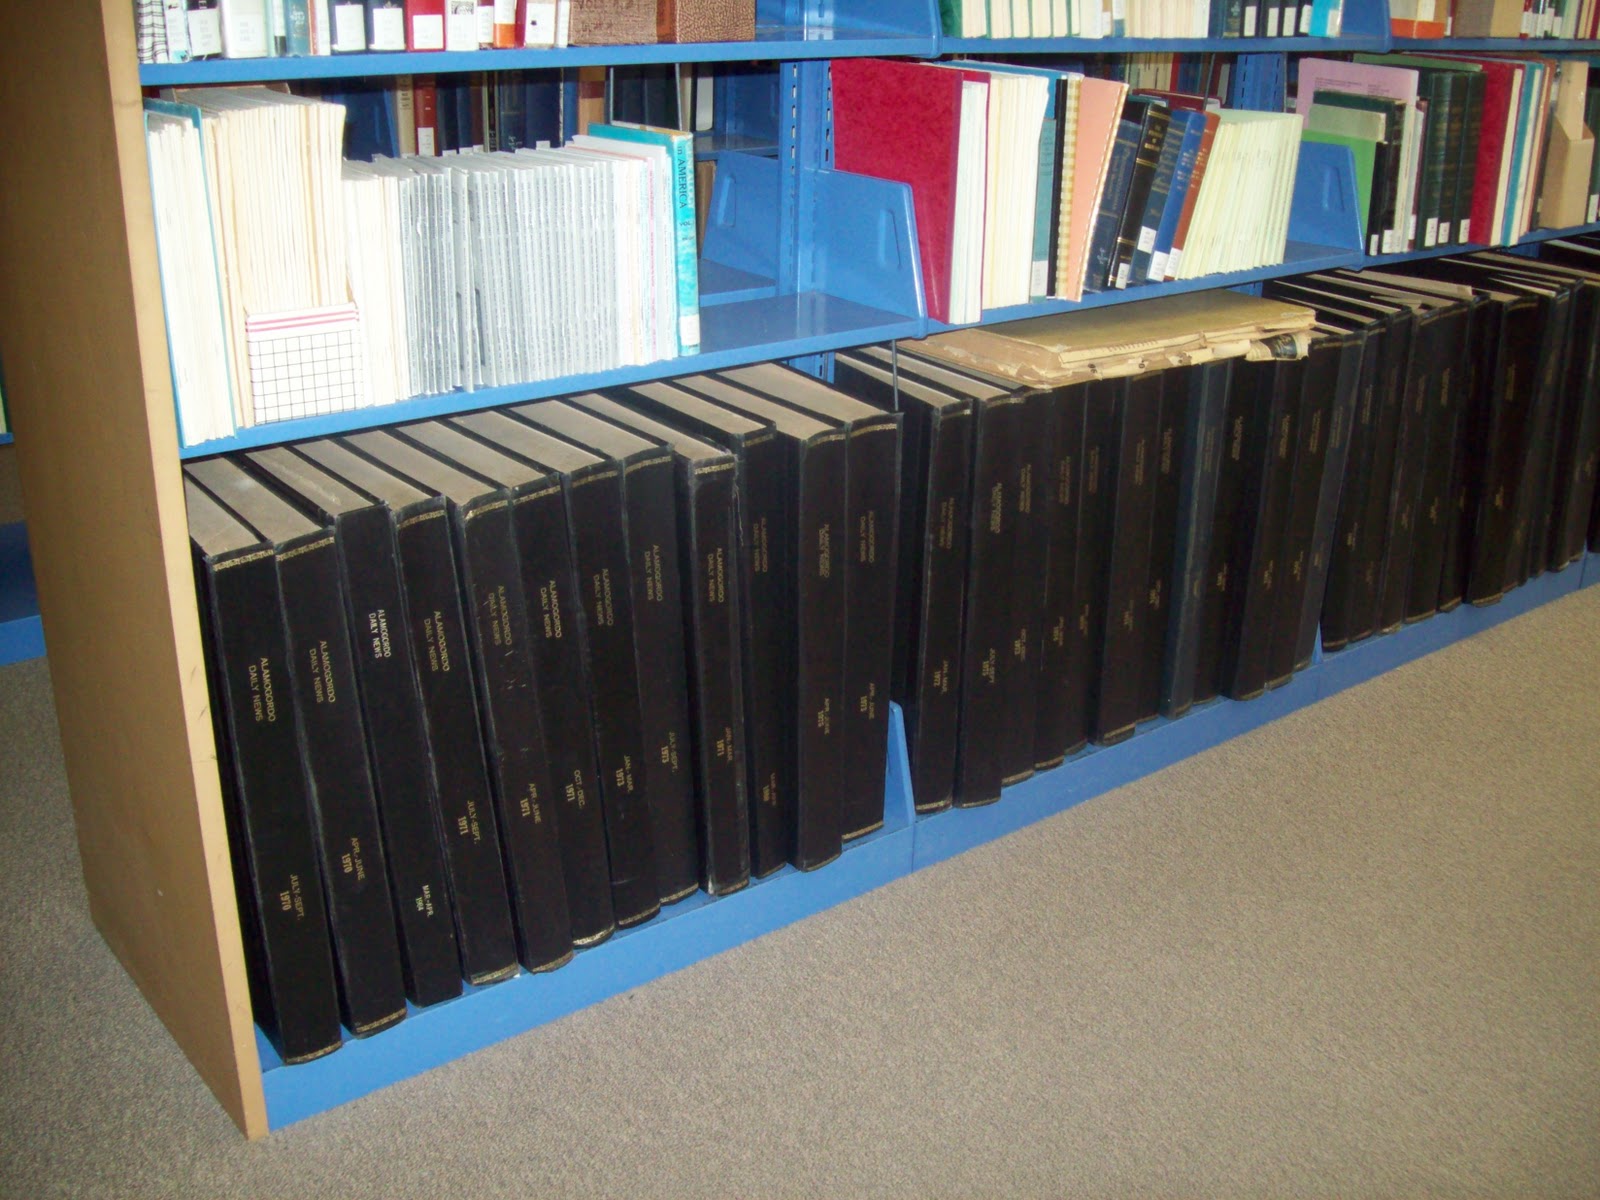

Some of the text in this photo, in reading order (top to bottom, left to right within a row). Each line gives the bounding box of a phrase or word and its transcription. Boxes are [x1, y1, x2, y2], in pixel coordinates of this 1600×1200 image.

[677, 146, 687, 208] in AMERICA
[601, 569, 614, 626] ALAMOGORDO
[644, 551, 654, 600] DAILY NEWS
[653, 545, 663, 601] ALAMOGORDO
[716, 548, 724, 602] ALAMOGORDO
[488, 593, 501, 645] DAILY NEWS
[498, 585, 513, 645] ALAMOGORDO
[540, 588, 552, 638] DAILY NEWS
[549, 580, 562, 638] ALAMOGORDO
[593, 575, 604, 625] DAILY NEWS
[368, 613, 382, 658] DAILY NEWS
[377, 609, 392, 657] ALAMOGORDO
[424, 619, 438, 672] DAILY NEWS
[434, 611, 450, 672] ALAMOGORDO
[248, 665, 263, 722] DAILY NEWS
[260, 657, 276, 722] ALAMOGORDO
[309, 649, 323, 703] DAILY NEWS
[319, 640, 336, 703] ALAMOGORDO
[519, 798, 530, 817] 1971
[565, 784, 575, 802] 1971
[458, 816, 468, 835] 1971
[341, 853, 352, 873] 1970
[280, 891, 291, 911] 1970
[289, 874, 304, 920] JULY-SEPT.
